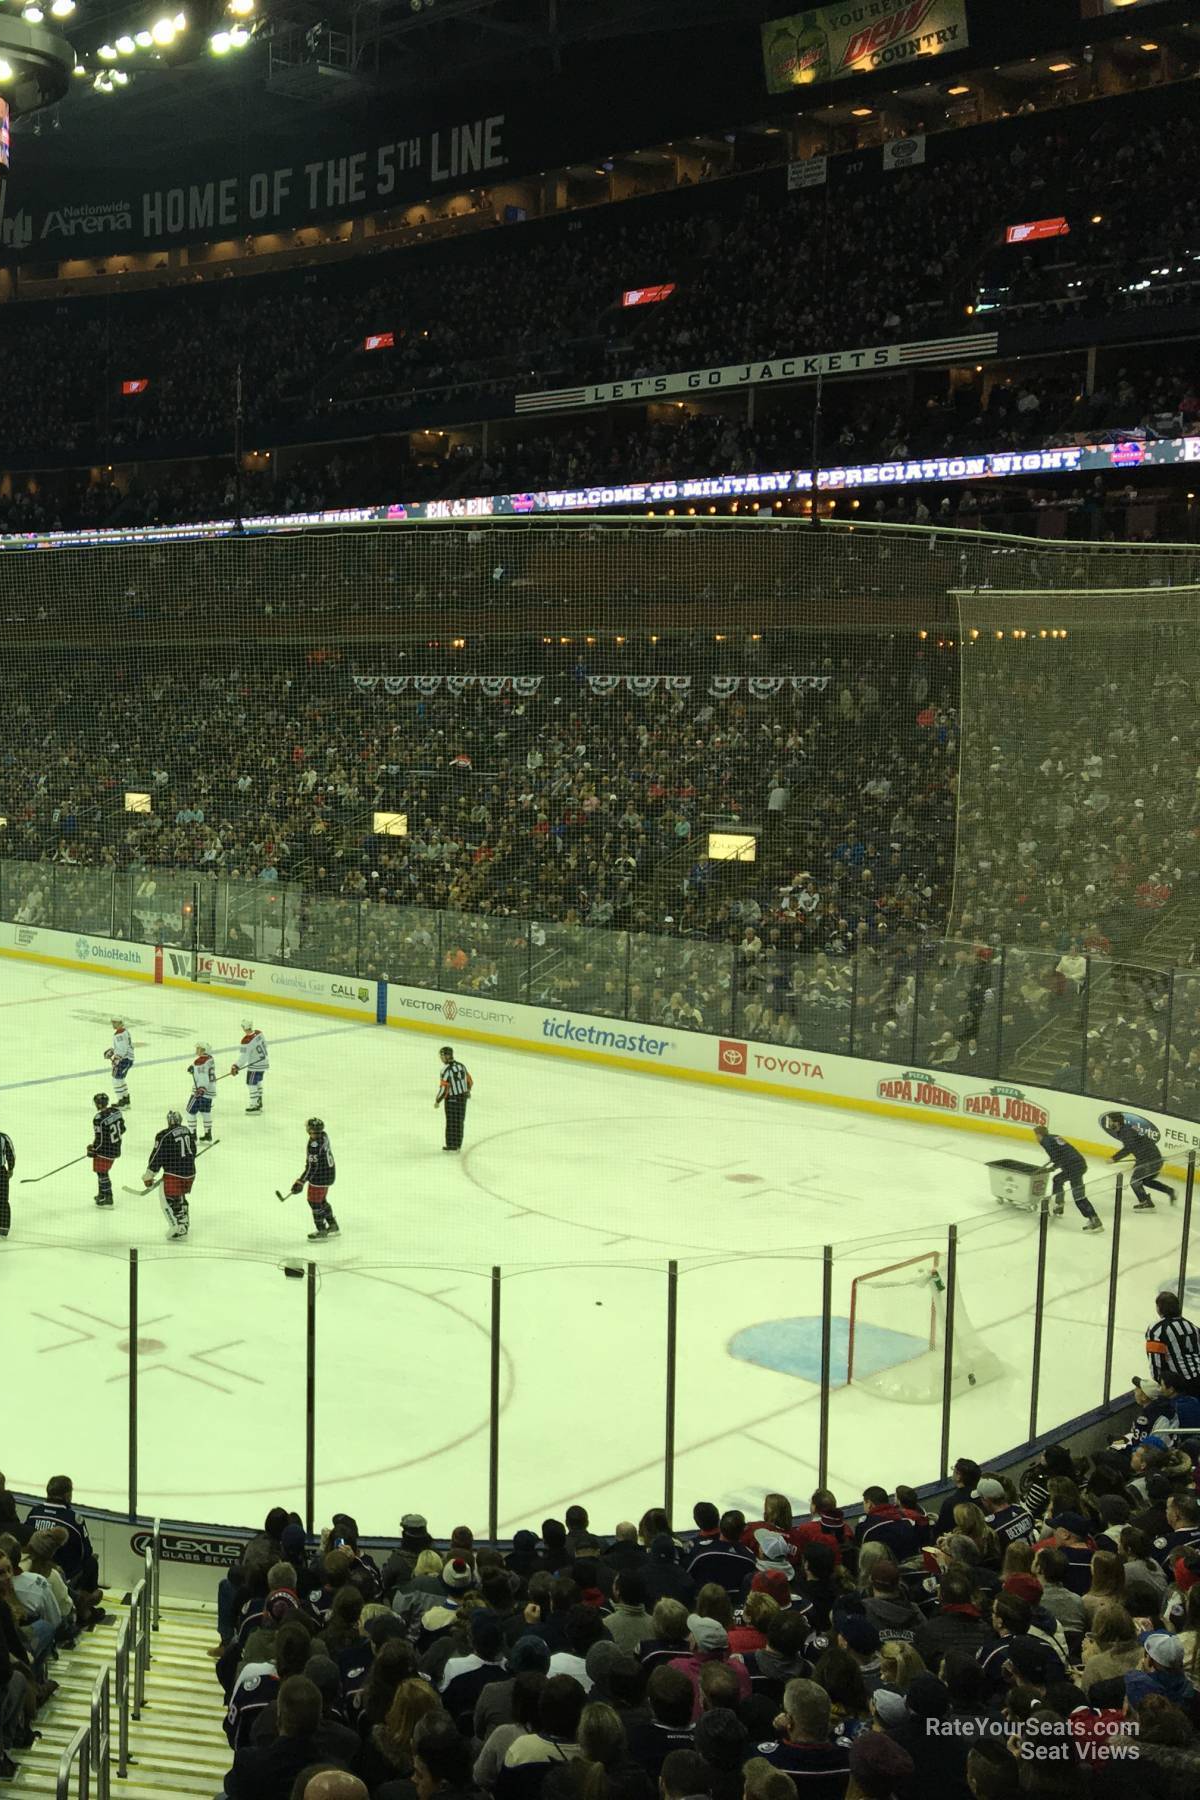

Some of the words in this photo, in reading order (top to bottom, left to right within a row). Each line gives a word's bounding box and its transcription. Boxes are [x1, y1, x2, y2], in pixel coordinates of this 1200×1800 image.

[870, 24, 958, 66] COUNTRY
[143, 178, 238, 237] HOME
[249, 168, 293, 219] OF
[304, 152, 367, 209] THE
[376, 137, 421, 196] 5TH
[64, 200, 131, 218] Nationwide
[39, 211, 132, 239] Arena
[593, 377, 667, 401] LET'S
[687, 370, 722, 388] GO
[738, 349, 891, 382] JACKETS
[548, 488, 646, 507] WELCOME
[650, 484, 678, 499] TO
[683, 474, 792, 497] MILITARY
[796, 458, 986, 489] APPRECIATION
[991, 450, 1081, 473] NIGHT
[426, 502, 450, 518] Elk
[452, 502, 464, 516] &
[466, 500, 492, 516] Elk
[90, 944, 142, 965] OhioHealth
[217, 958, 255, 980] Wyler
[331, 983, 356, 997] CALL
[399, 997, 442, 1012] VECTOR
[458, 1008, 514, 1025] SECURITY
[542, 1017, 669, 1057] ticketmaster
[754, 1054, 824, 1080] TOYOTA
[879, 1080, 912, 1099] PAPA
[914, 1083, 958, 1110] JOHNS
[965, 1095, 1000, 1117] PAPA
[1002, 1099, 1048, 1127] JOHNS
[1165, 1128, 1189, 1144] FEEL
[162, 1537, 241, 1557] LEXUS
[162, 1551, 200, 1561] GLASS
